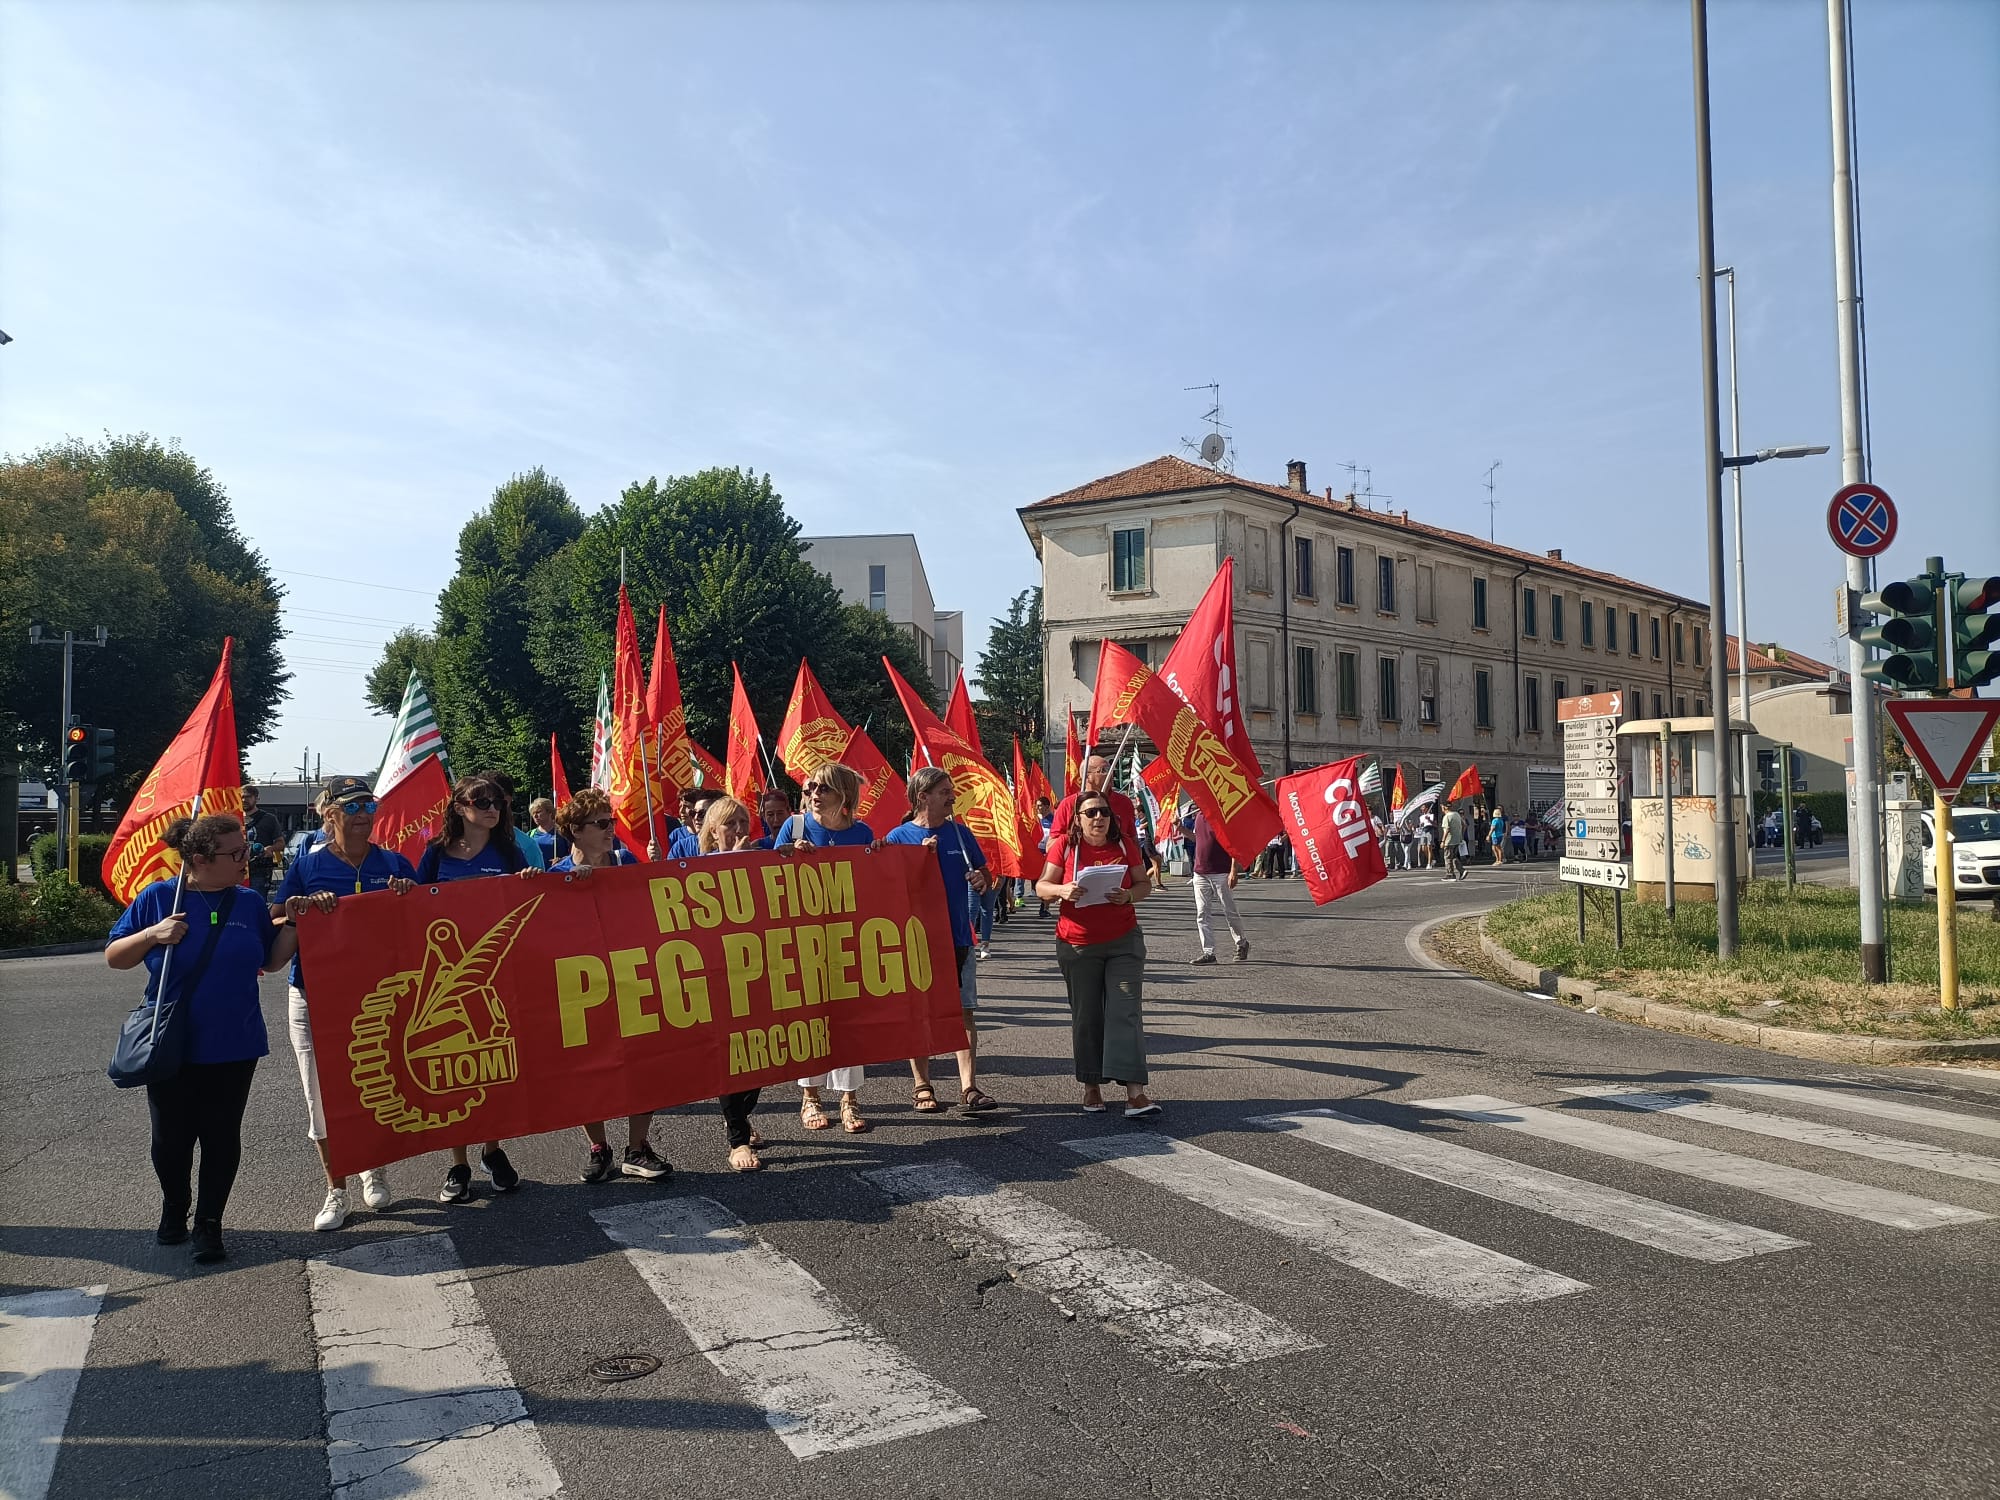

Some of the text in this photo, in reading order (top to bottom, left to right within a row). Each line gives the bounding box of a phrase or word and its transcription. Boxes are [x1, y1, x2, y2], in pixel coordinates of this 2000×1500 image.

[1112, 690, 1138, 719] CGIL
[795, 746, 824, 774] FIO
[1565, 743, 1590, 751] biblioteca
[1565, 751, 1581, 759] civica
[856, 765, 892, 818] GIL BRIANZ
[1194, 750, 1243, 816] FIOM
[1566, 782, 1584, 790] piscina
[1566, 790, 1590, 798] comunale
[1324, 778, 1370, 860] CGIL
[1587, 824, 1618, 836] parcheggio
[1287, 791, 1329, 881] Monza e Brianza
[1567, 849, 1589, 857] stradale
[1561, 864, 1602, 879] polizia locale
[649, 861, 857, 933] RSU FIOM
[555, 915, 932, 1048] PEG PEREGO
[427, 1048, 508, 1090] FIOM
